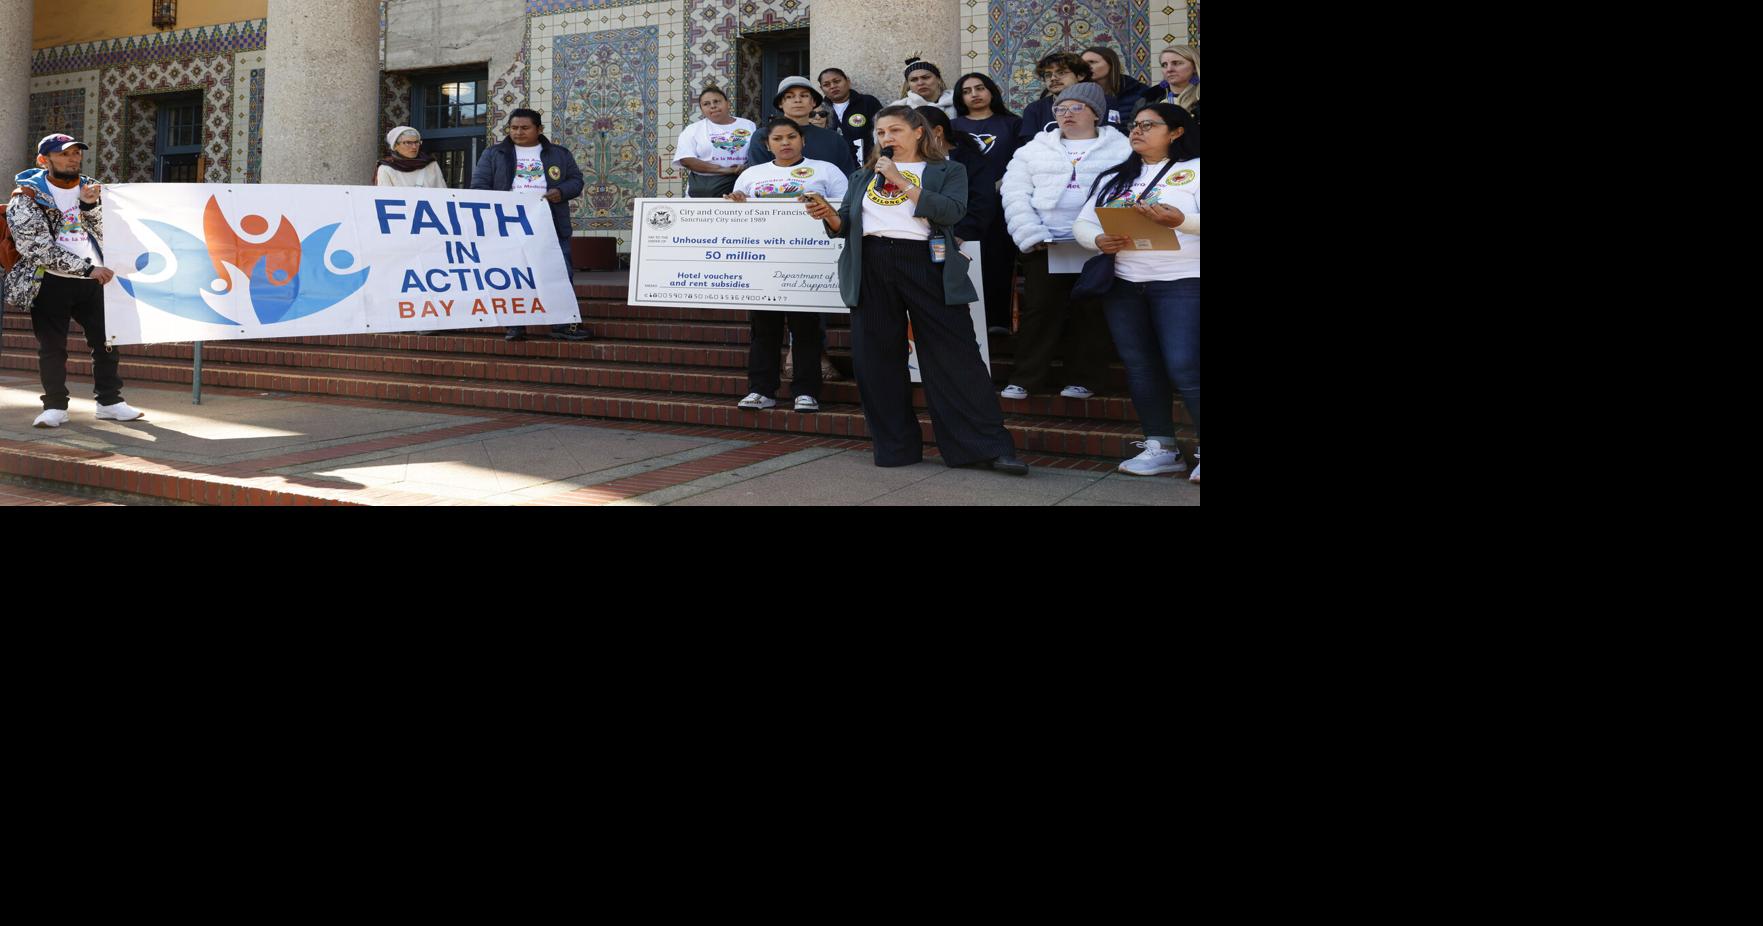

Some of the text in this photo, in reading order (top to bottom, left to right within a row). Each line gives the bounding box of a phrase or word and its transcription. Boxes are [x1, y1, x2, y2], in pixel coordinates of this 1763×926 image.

[374, 199, 534, 237] FAITH
[679, 208, 808, 217] City and County of San Francisc
[672, 236, 718, 245] Unhoused
[721, 236, 760, 246] families
[764, 237, 786, 246] with
[789, 237, 830, 246] children
[445, 240, 481, 264] IN
[705, 250, 766, 261] 50 million
[401, 266, 537, 293] ACTION
[677, 271, 743, 280] Hotel vouchers
[772, 270, 835, 282] Department of
[689, 280, 707, 288] rent
[711, 280, 750, 289] subsidies
[781, 279, 839, 291] and Supporti
[398, 297, 547, 319] BAY AREA
